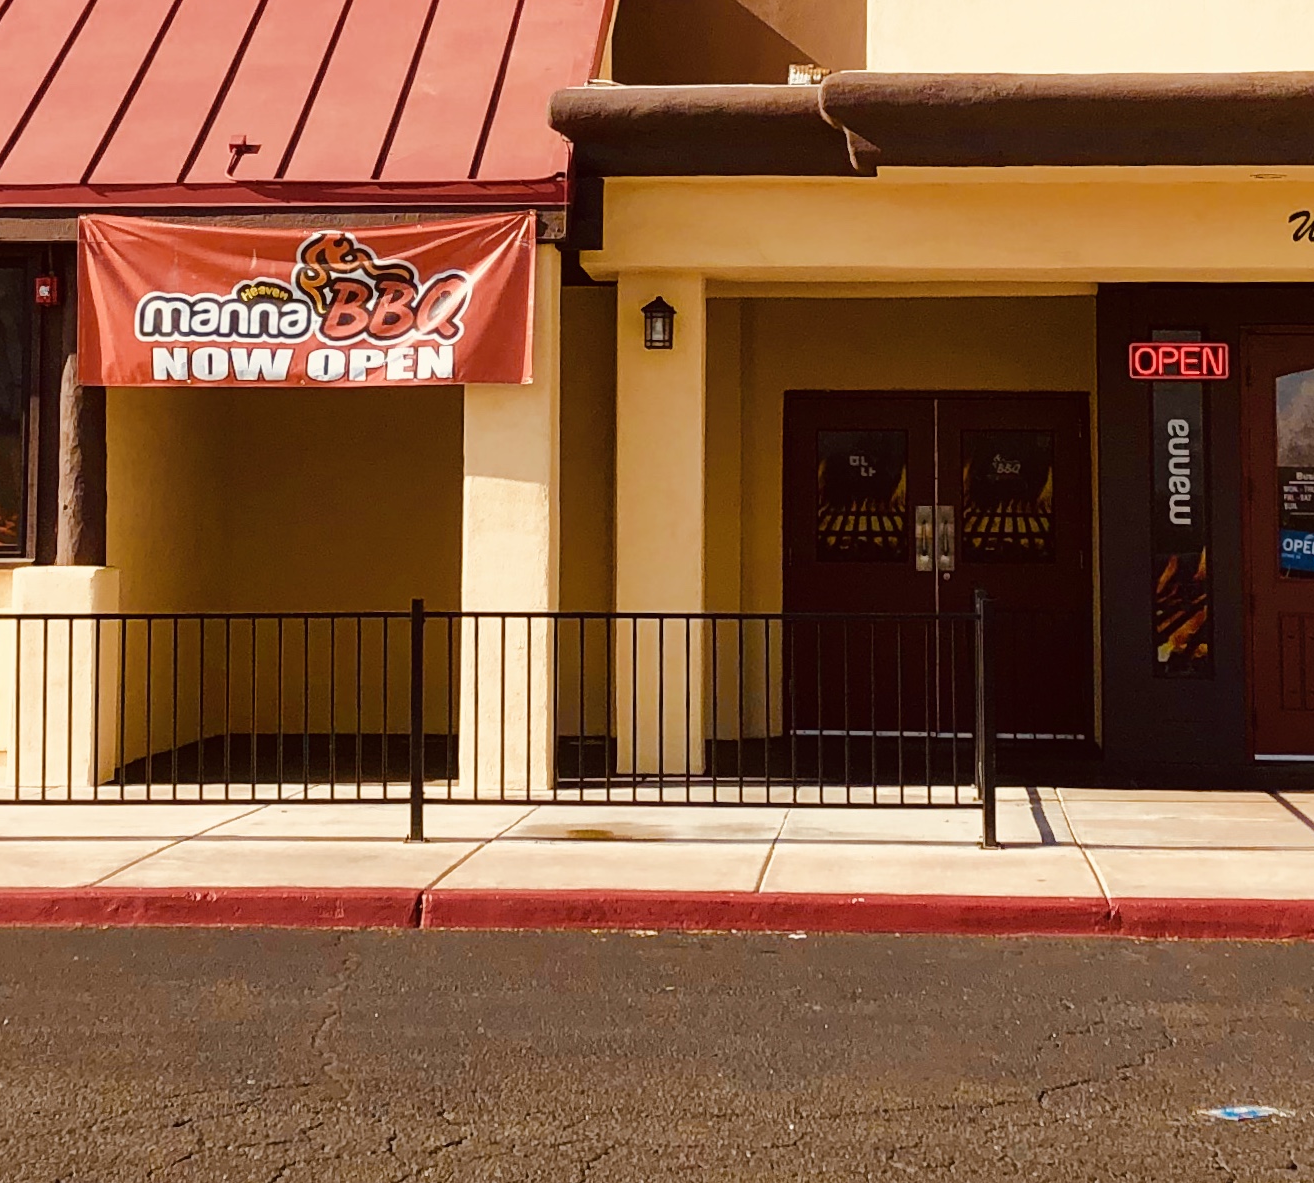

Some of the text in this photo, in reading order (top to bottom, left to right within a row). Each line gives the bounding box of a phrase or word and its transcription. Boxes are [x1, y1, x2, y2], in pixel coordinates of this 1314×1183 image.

[140, 274, 468, 339] manna BBQ
[241, 283, 288, 302] Heaven
[151, 345, 455, 382] NOW OPEN
[1134, 346, 1224, 376] OPEN
[1167, 418, 1192, 525] manna
